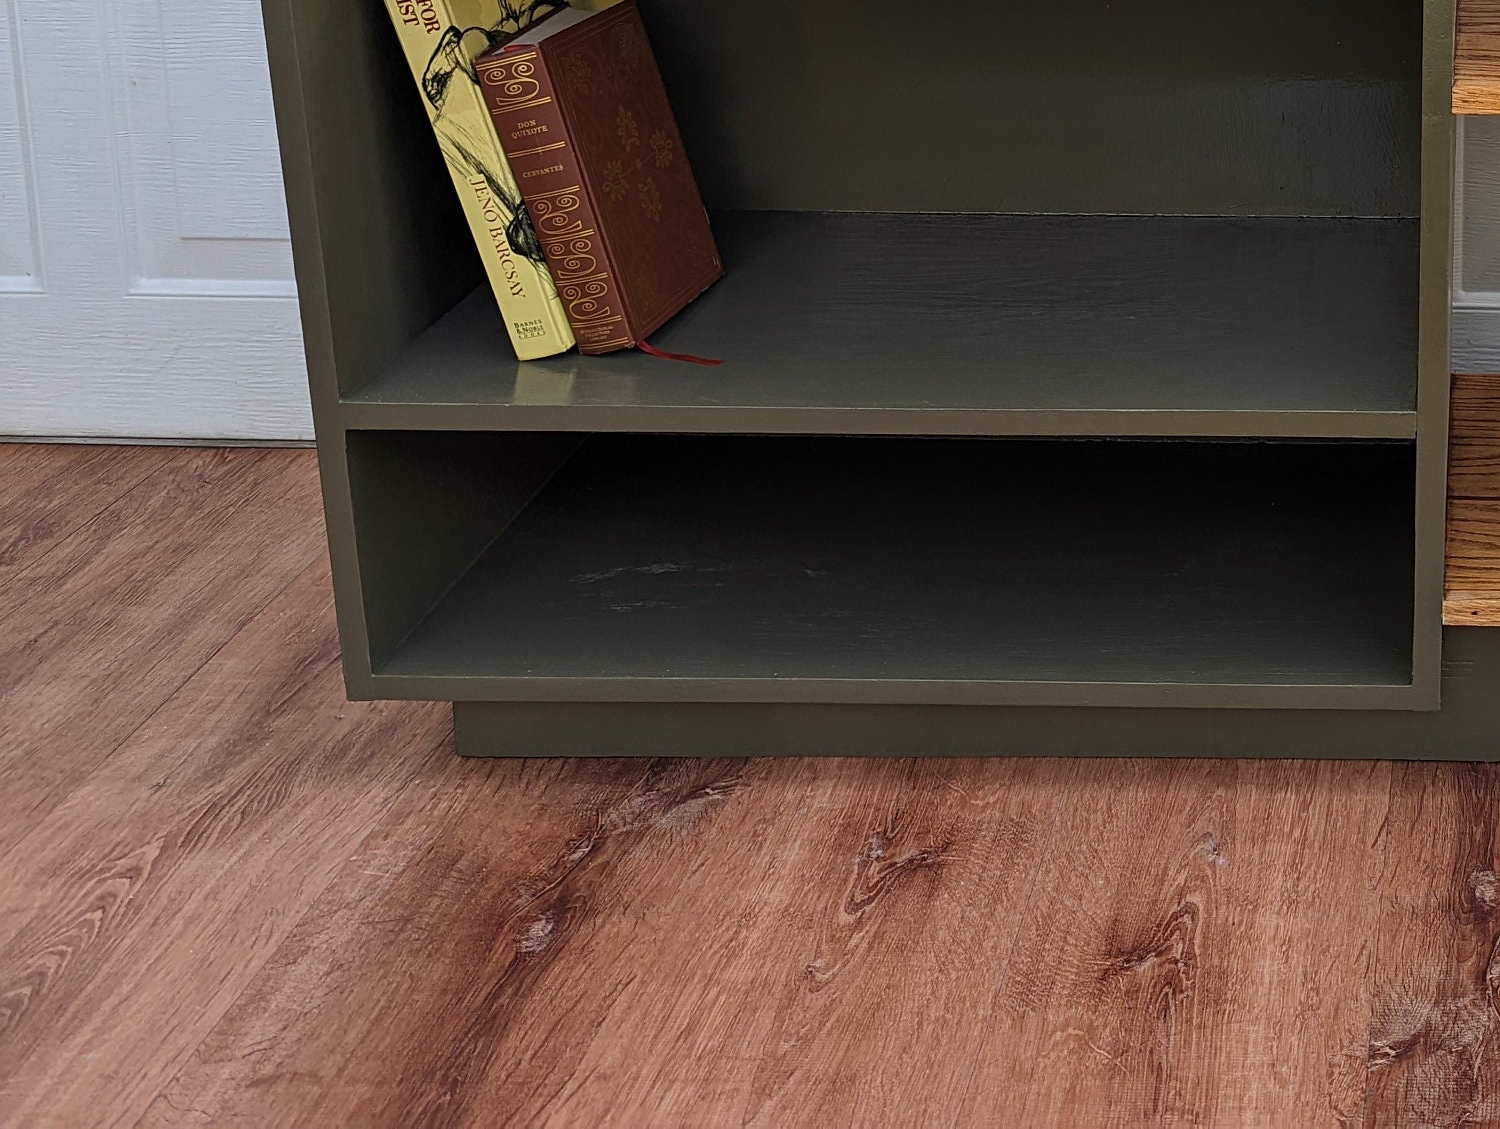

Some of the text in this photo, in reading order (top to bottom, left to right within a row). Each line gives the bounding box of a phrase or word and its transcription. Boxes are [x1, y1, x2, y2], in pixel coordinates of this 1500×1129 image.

[517, 119, 537, 129] DON
[511, 125, 549, 140] QUIXOTE
[522, 164, 564, 178] CERVANTES
[489, 226, 526, 299] BARCSAY
[514, 319, 542, 329] BARNES
